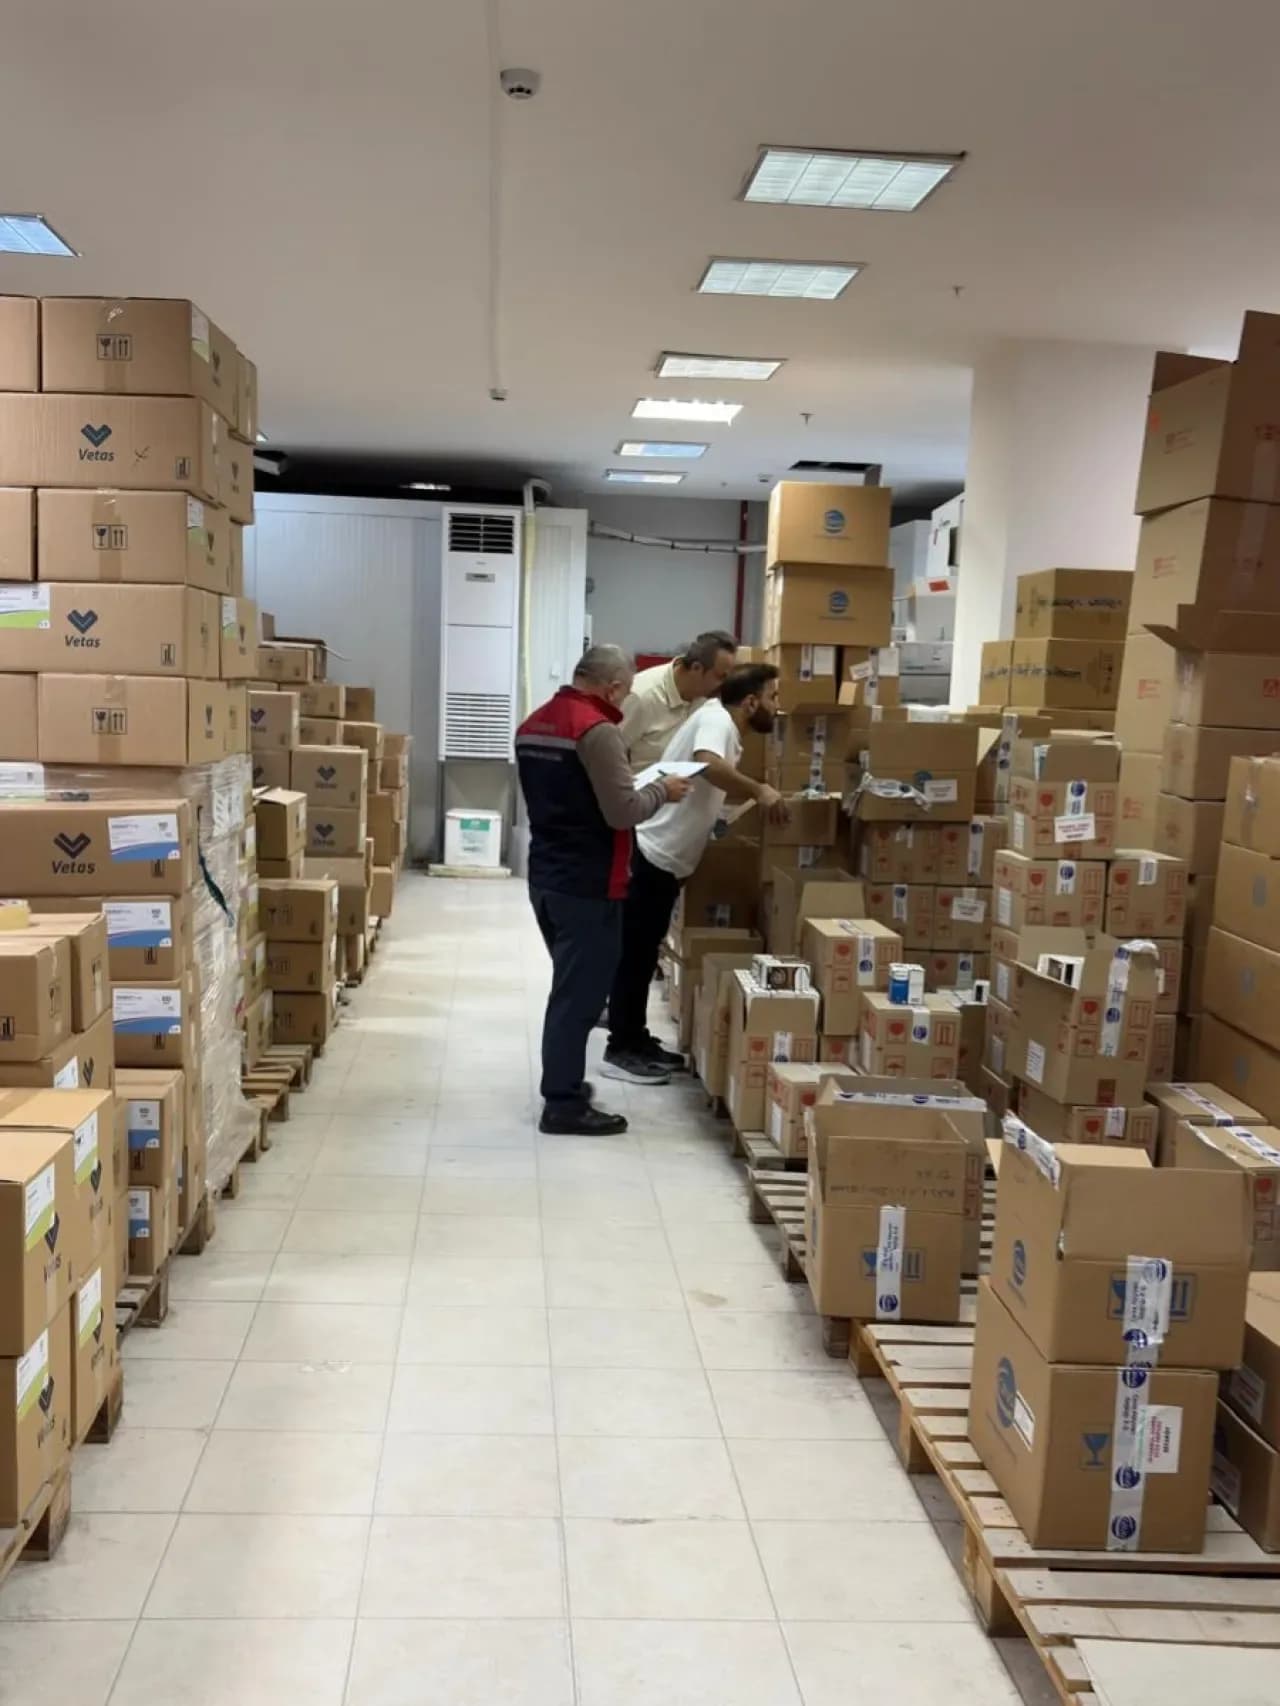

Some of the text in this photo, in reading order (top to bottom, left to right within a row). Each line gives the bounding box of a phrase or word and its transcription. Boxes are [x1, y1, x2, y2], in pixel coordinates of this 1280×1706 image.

[78, 448, 115, 461] Vetas
[64, 635, 101, 648] Vetas
[52, 861, 95, 874] Vetas
